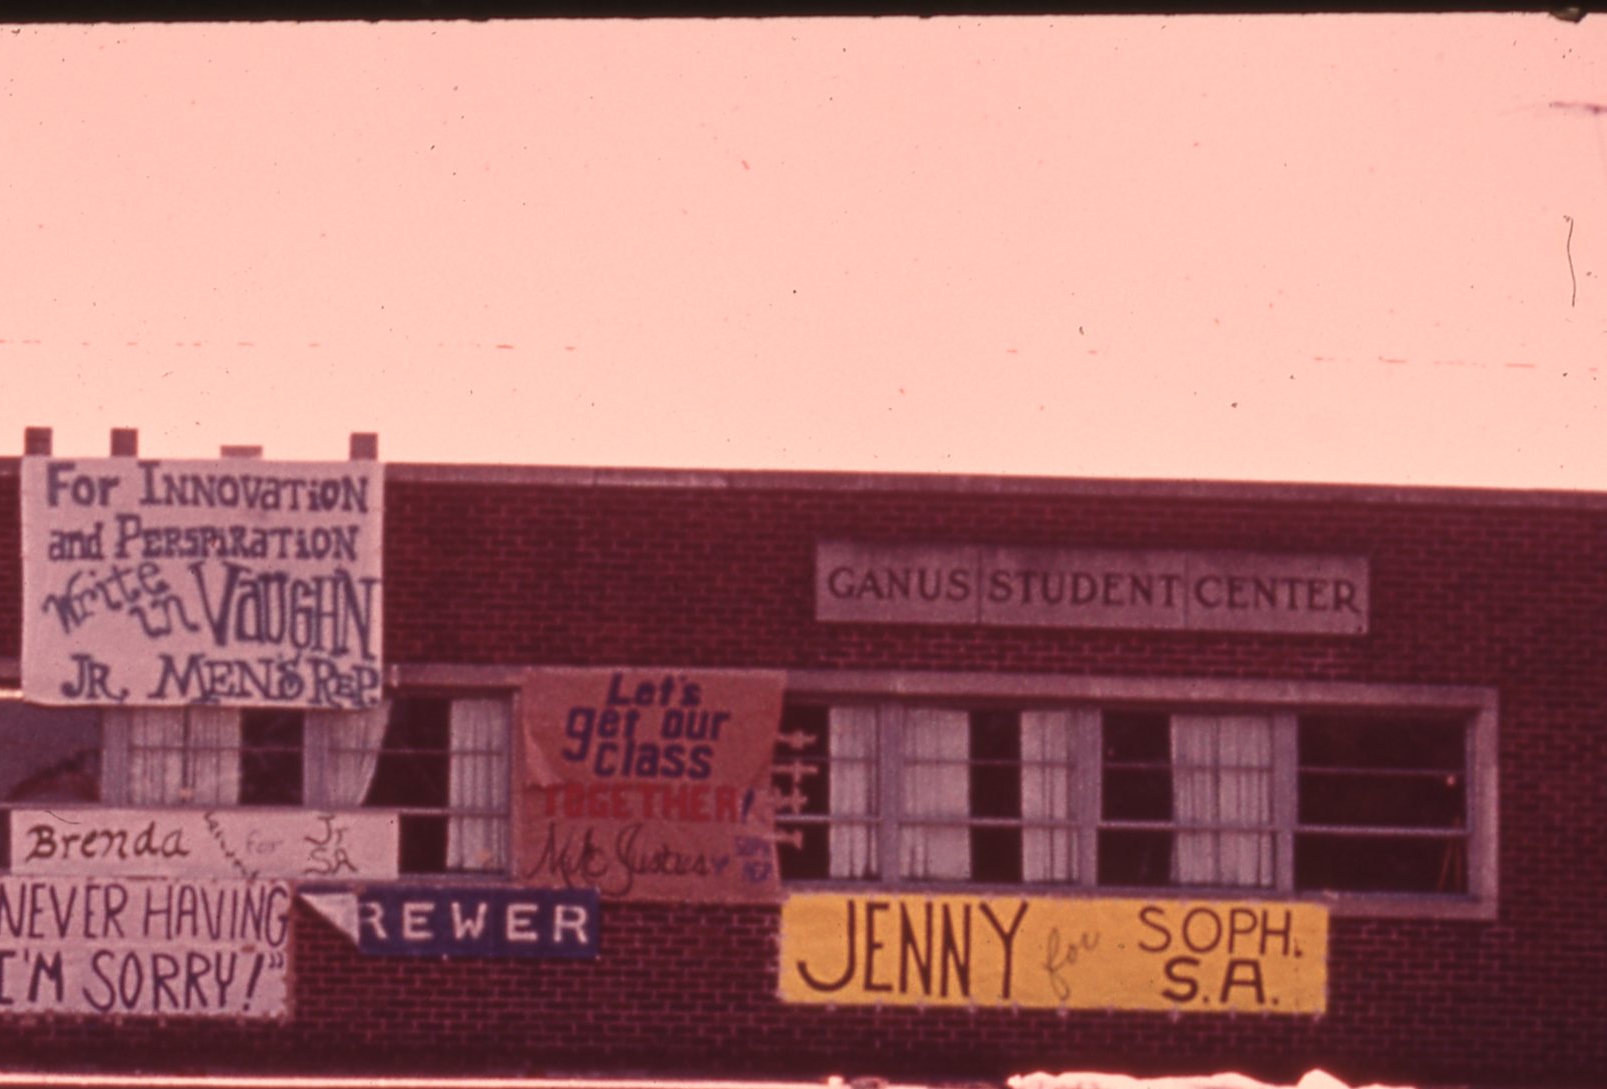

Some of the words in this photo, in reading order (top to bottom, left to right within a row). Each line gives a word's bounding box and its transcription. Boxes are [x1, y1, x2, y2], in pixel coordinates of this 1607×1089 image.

[45, 462, 120, 508] For
[47, 521, 105, 562] and
[826, 565, 972, 602] GANUS
[992, 567, 1180, 609] STUDENT
[1196, 572, 1361, 615] CENTER
[128, 592, 202, 639] in
[560, 705, 641, 763] get
[659, 708, 733, 742] our
[593, 740, 715, 780] class
[24, 821, 191, 862] Brenda
[302, 845, 358, 877] SA
[142, 883, 291, 949] HAVING
[796, 898, 1030, 1000] JENNY
[1040, 925, 1102, 1002] for
[1137, 904, 1304, 960] SOPH.
[1160, 954, 1281, 1006] S.A.
